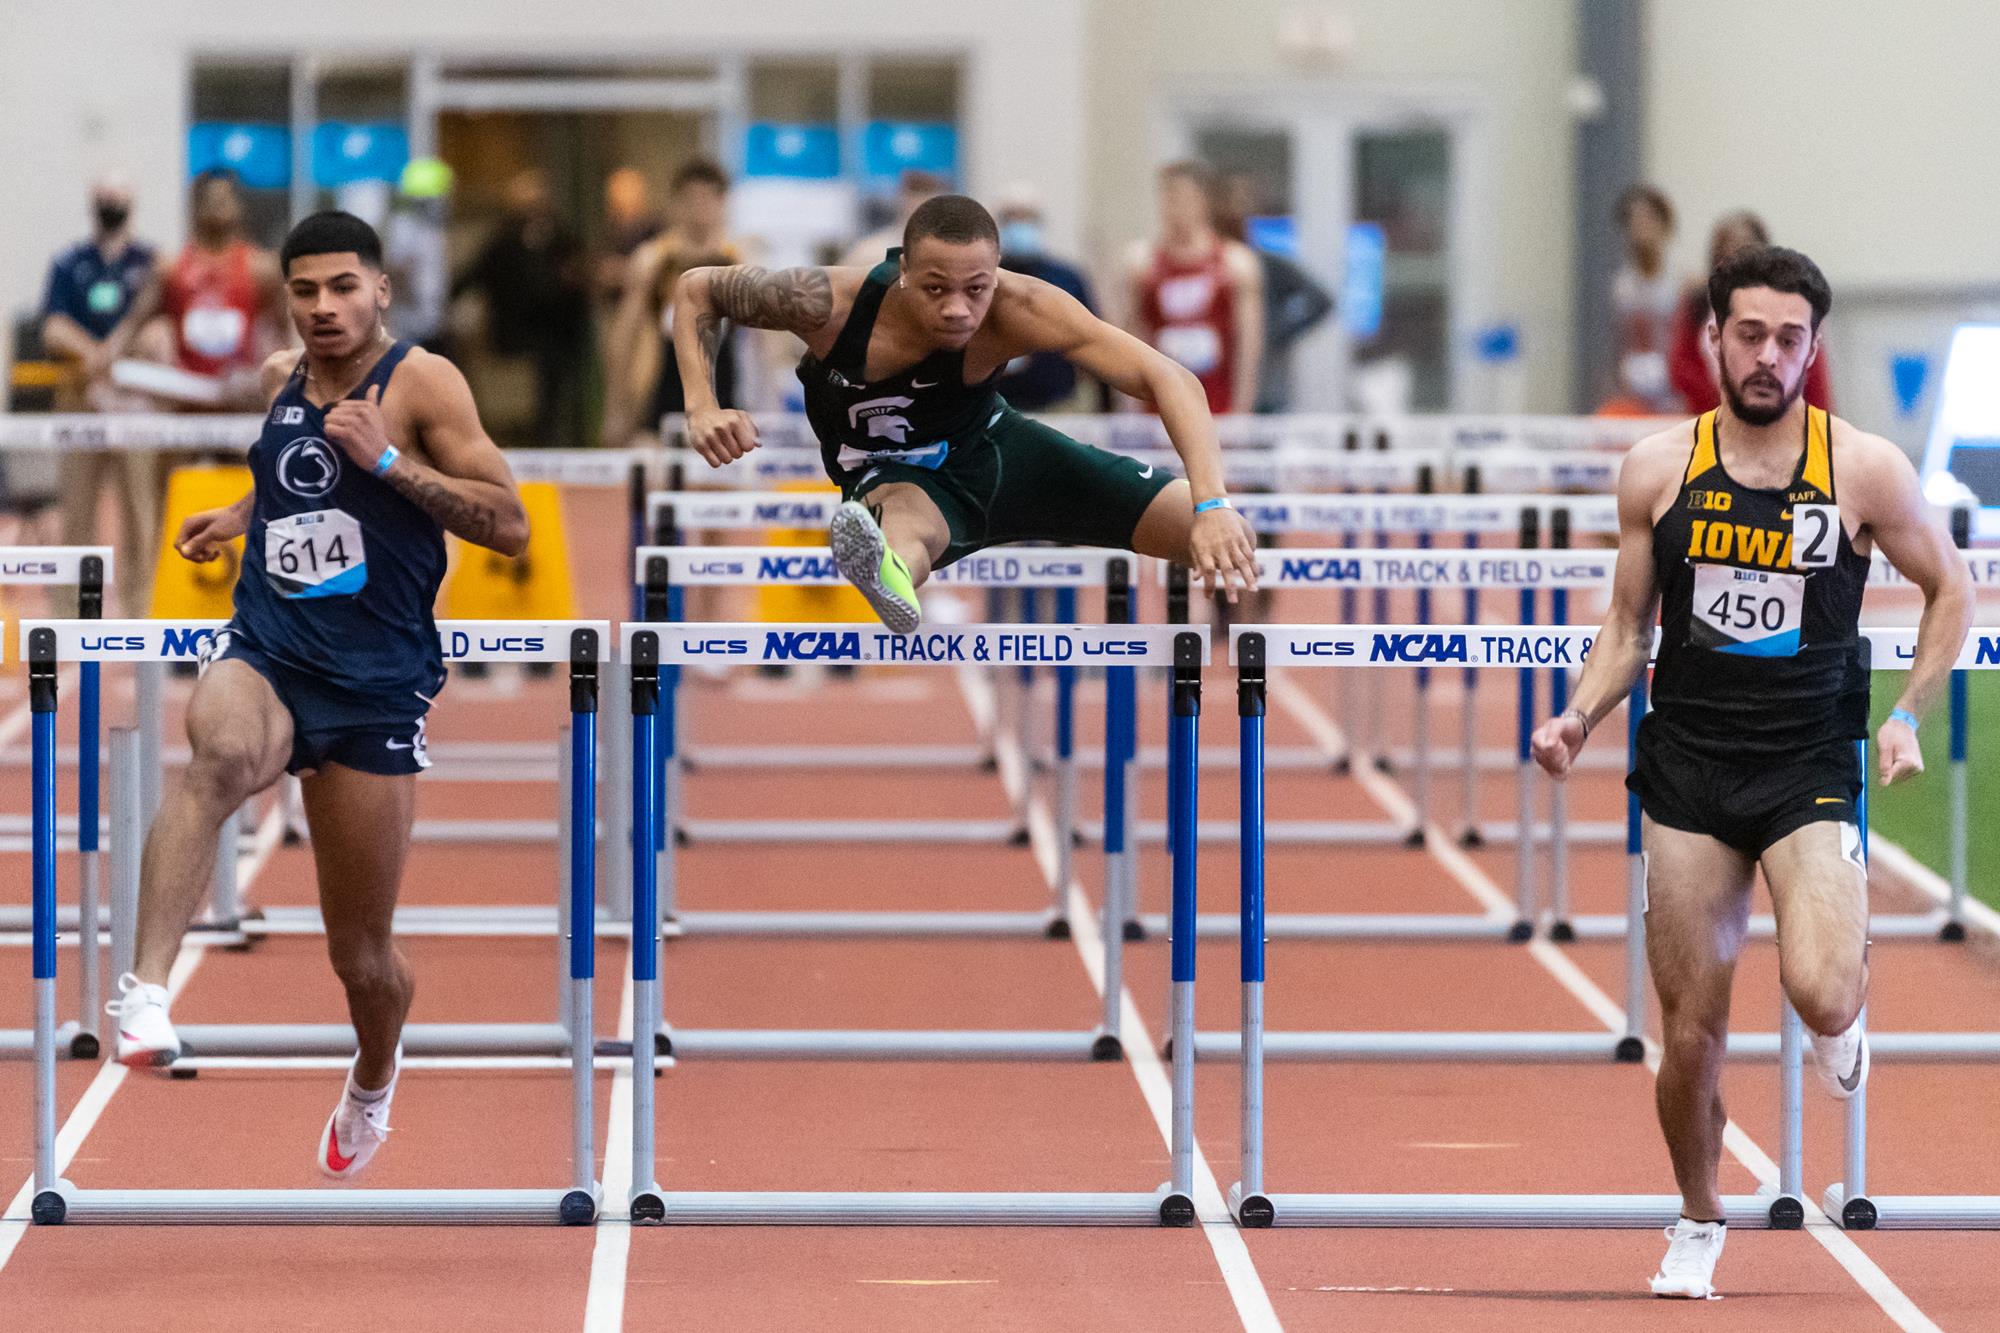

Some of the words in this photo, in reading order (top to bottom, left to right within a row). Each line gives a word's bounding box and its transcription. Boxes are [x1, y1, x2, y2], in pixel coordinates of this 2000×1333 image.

[1788, 490, 1817, 503] RAFF
[1801, 508, 1830, 563] 2
[278, 534, 350, 574] 614
[2, 561, 58, 575] UCS
[689, 562, 744, 576] UCS
[757, 556, 840, 580] NCAA
[957, 558, 1020, 581] FIELD
[1028, 563, 1083, 577] UCS
[1280, 558, 1361, 582] NCAA
[1373, 559, 1449, 582] TRACK
[1458, 560, 1471, 582] &
[1479, 560, 1542, 583] FIELD
[1551, 565, 1606, 578] UCS
[1707, 590, 1785, 631] 450
[80, 636, 145, 651] UCS
[160, 628, 214, 657] NC
[480, 637, 545, 652] UCS
[683, 639, 748, 654] UCS
[762, 632, 861, 660] NCAA
[874, 634, 965, 661] TRACK
[973, 634, 991, 661] &
[1000, 634, 1073, 662] FIELD
[1083, 640, 1148, 655] UCS
[1290, 641, 1355, 656] UCS
[1370, 634, 1468, 662] NCAA
[1481, 636, 1572, 664] TRACK
